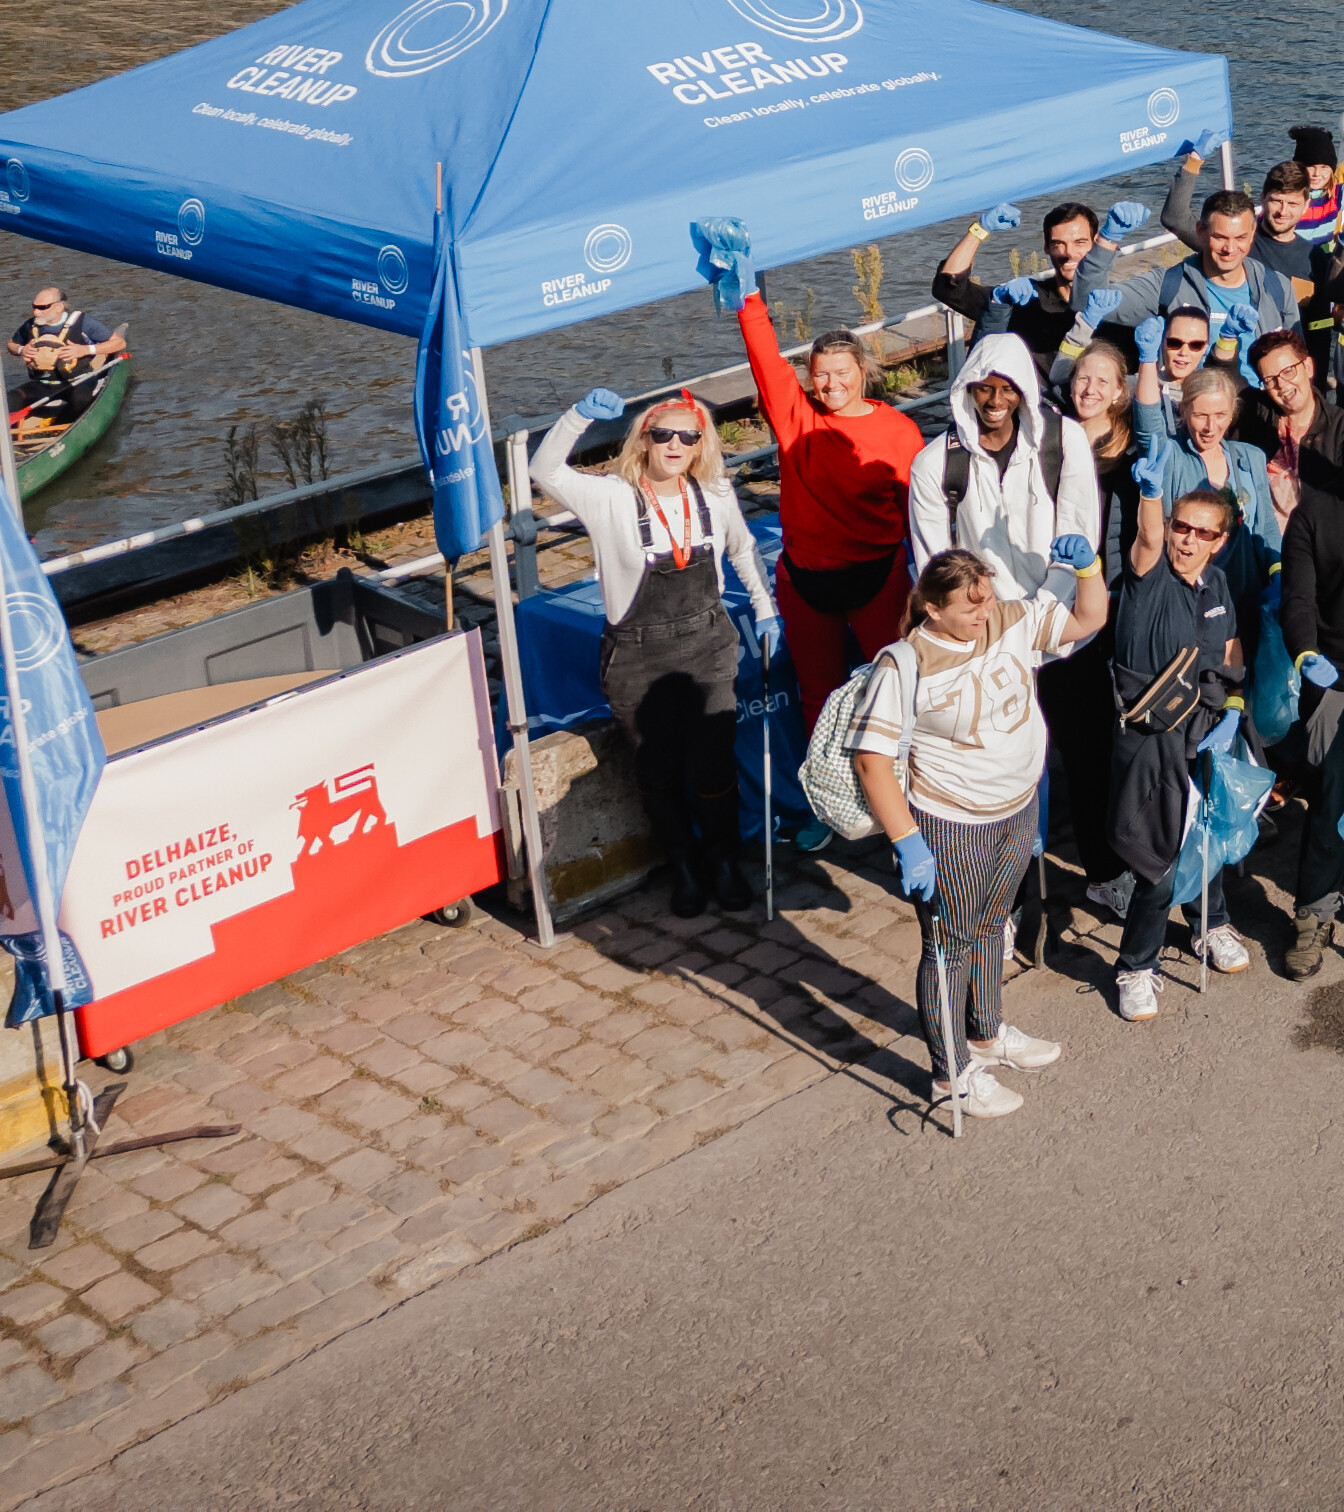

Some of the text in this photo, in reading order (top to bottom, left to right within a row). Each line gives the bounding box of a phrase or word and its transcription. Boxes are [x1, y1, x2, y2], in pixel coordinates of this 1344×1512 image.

[255, 44, 343, 75] RIVER
[646, 41, 773, 85] RIVER
[227, 66, 358, 107] CLEANUP
[672, 52, 849, 105] CLEANUP
[192, 102, 225, 117] Clean
[703, 70, 942, 128] Clean locally, celebrate globally.
[1119, 126, 1149, 144] RIVER
[1121, 132, 1167, 153] CLEANUP
[862, 191, 897, 209] RIVER
[863, 197, 919, 221] CLEANUP
[155, 231, 179, 246] RIVER
[157, 243, 193, 260] CLEANUP
[351, 278, 378, 295] RIVER
[541, 273, 585, 295] RIVER
[543, 278, 613, 306] CLEANUP
[352, 292, 396, 310] CLEANUP
[928, 651, 1031, 750] 78
[125, 822, 238, 881] DELHAIZE,
[113, 839, 254, 907] PROUD PARTNER OF
[99, 852, 273, 939] RIVER CLEANUP
